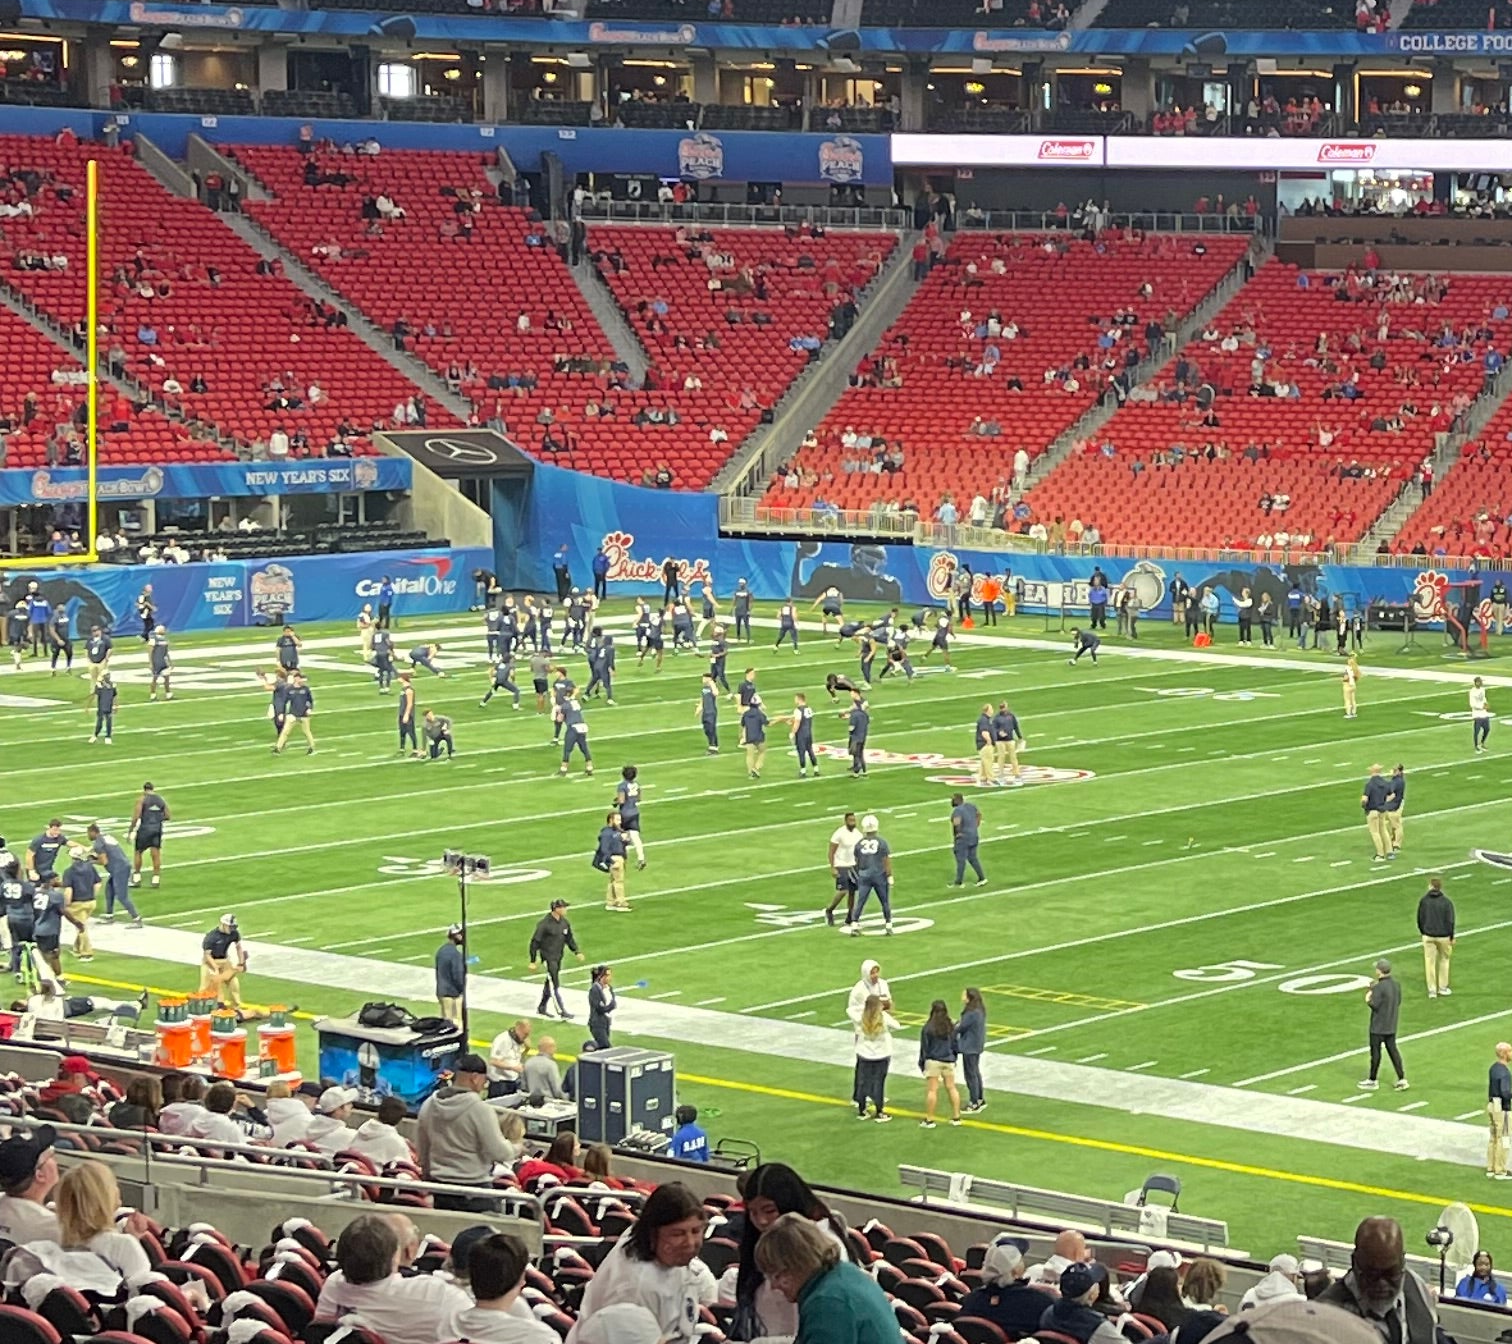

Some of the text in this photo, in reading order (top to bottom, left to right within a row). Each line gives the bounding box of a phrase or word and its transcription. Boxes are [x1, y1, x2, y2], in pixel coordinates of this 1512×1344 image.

[1399, 35, 1478, 51] COLLEGE
[1041, 141, 1084, 156] Coleman
[1320, 144, 1364, 159] Coleman
[245, 472, 278, 486] NEW
[281, 470, 327, 484] YEAR'S
[328, 469, 351, 482] SIX
[208, 576, 236, 588] NEW
[204, 589, 242, 602] YEAR'S
[213, 603, 233, 615] SIX
[860, 838, 879, 855] 33
[1172, 959, 1376, 995] 50
